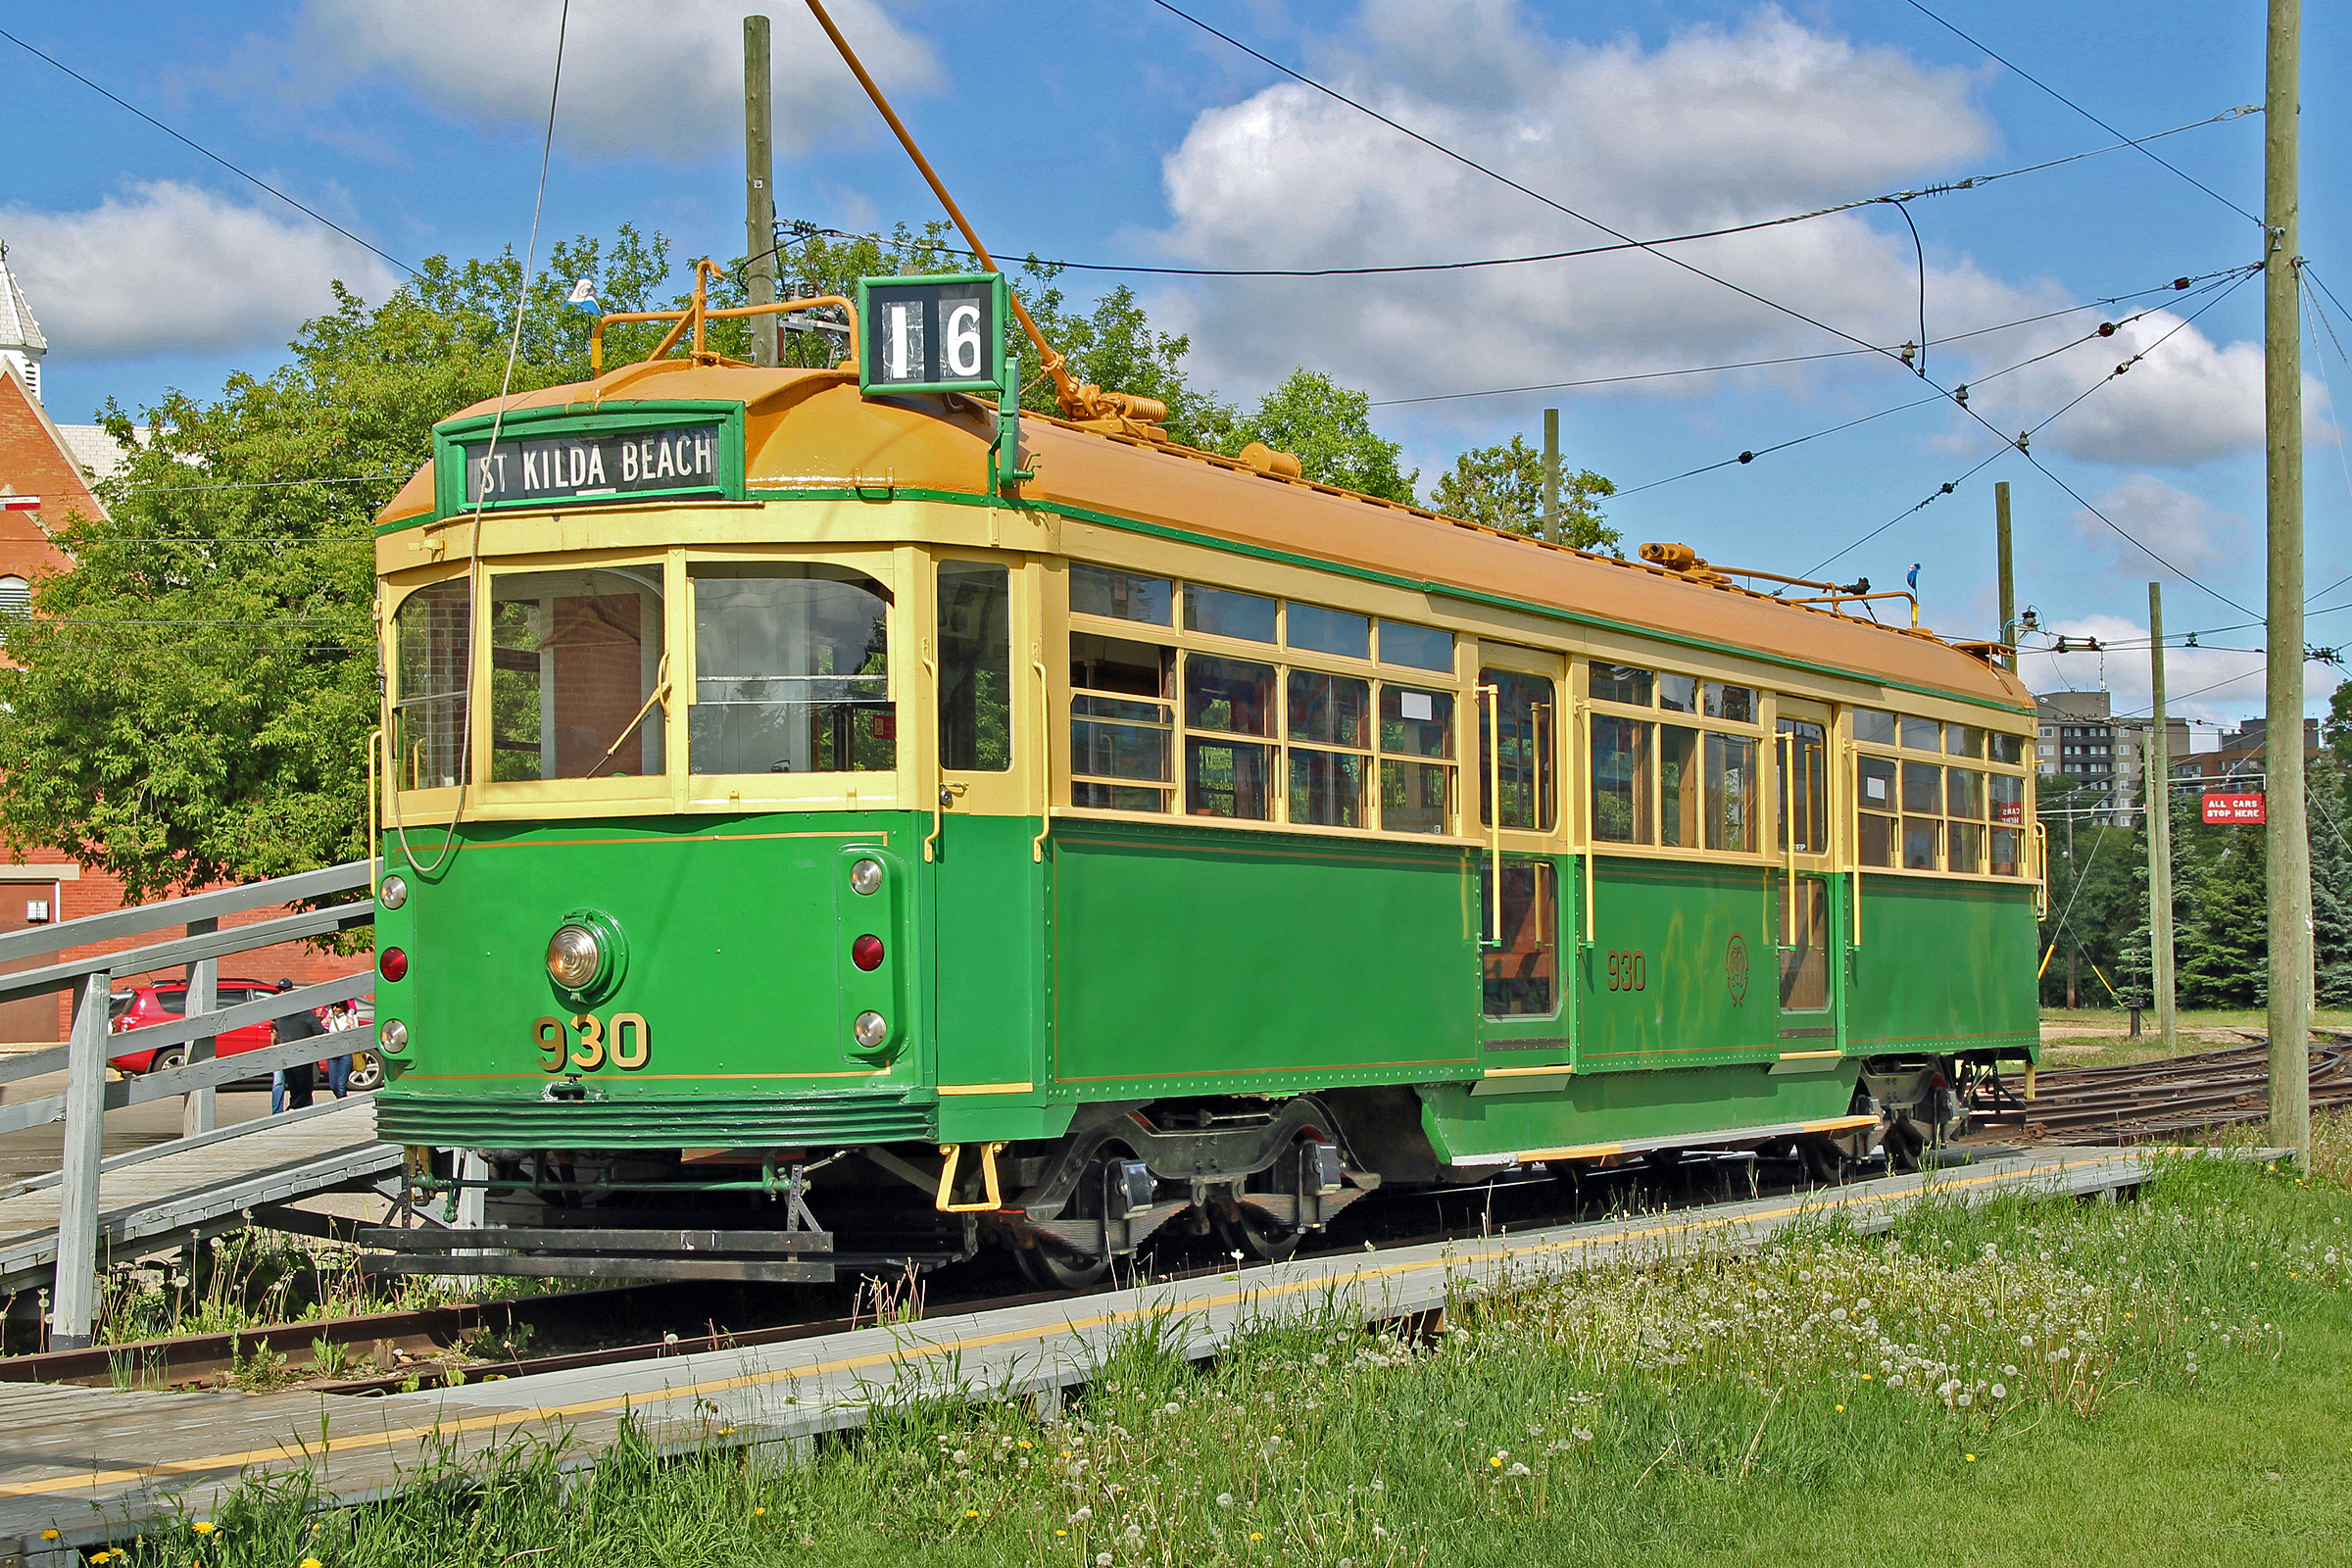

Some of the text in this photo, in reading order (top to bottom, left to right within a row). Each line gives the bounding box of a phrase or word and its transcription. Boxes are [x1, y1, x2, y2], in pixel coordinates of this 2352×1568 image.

[891, 305, 981, 379] 16
[480, 433, 711, 494] ST KILDA BEACH
[2208, 800, 2258, 808] ALL CARS
[1607, 949, 1646, 992] 930
[532, 1012, 652, 1074] 930
